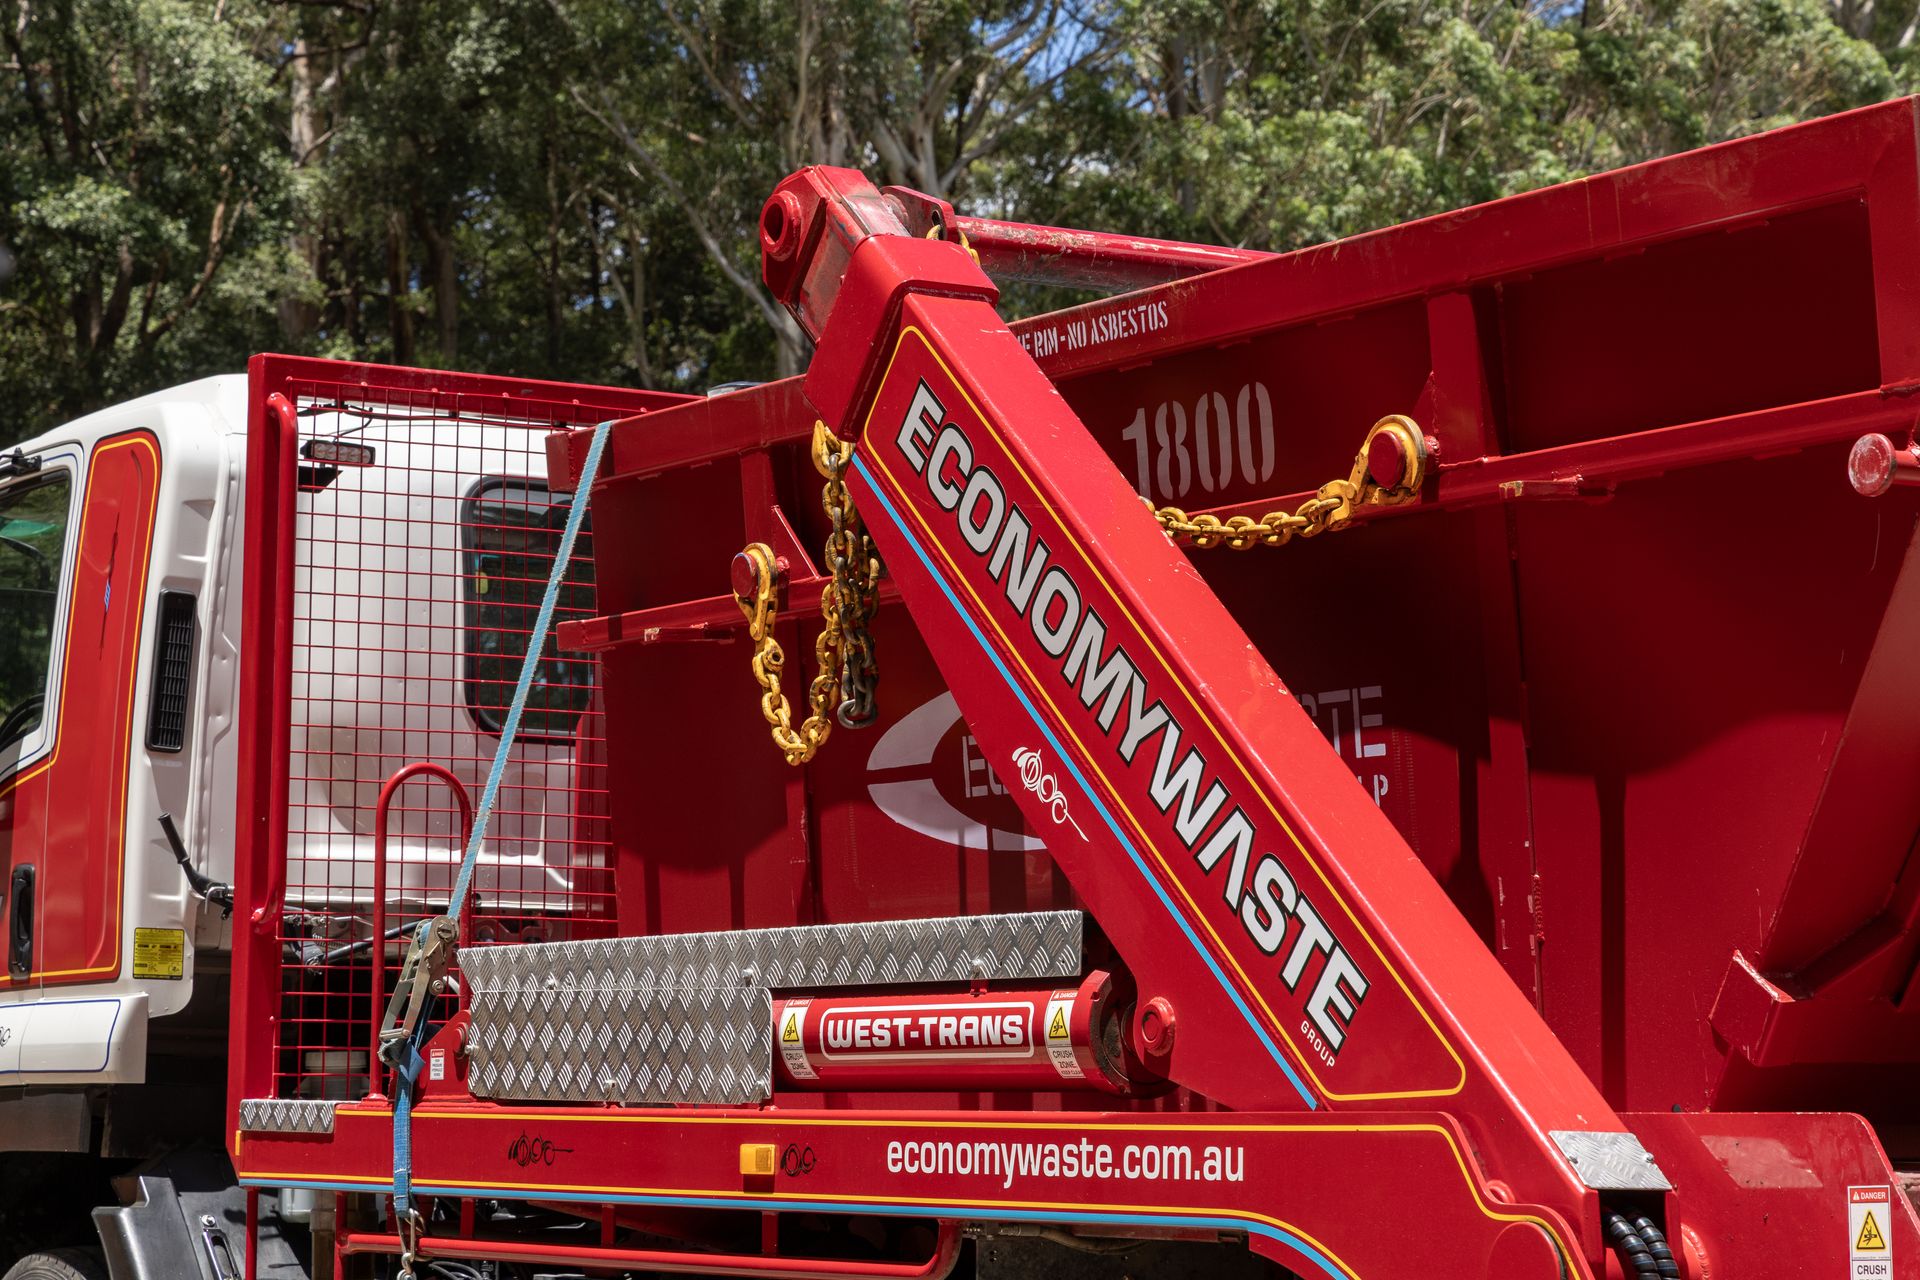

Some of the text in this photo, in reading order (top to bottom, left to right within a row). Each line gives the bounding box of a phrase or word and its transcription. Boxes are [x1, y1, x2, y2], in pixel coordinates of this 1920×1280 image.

[1091, 301, 1169, 345] ASBESTOS
[1122, 381, 1275, 500] 1800
[895, 377, 1371, 1057] ECONOMYWASTE
[828, 1015, 1024, 1048] WEST-TRANS
[1301, 1020, 1336, 1068] GROUP
[1052, 1050, 1074, 1059] CRUSH
[887, 1137, 1245, 1188] economywaste.com.au
[1860, 1192, 1886, 1200] DANGER
[1857, 1265, 1887, 1275] CRUSH
